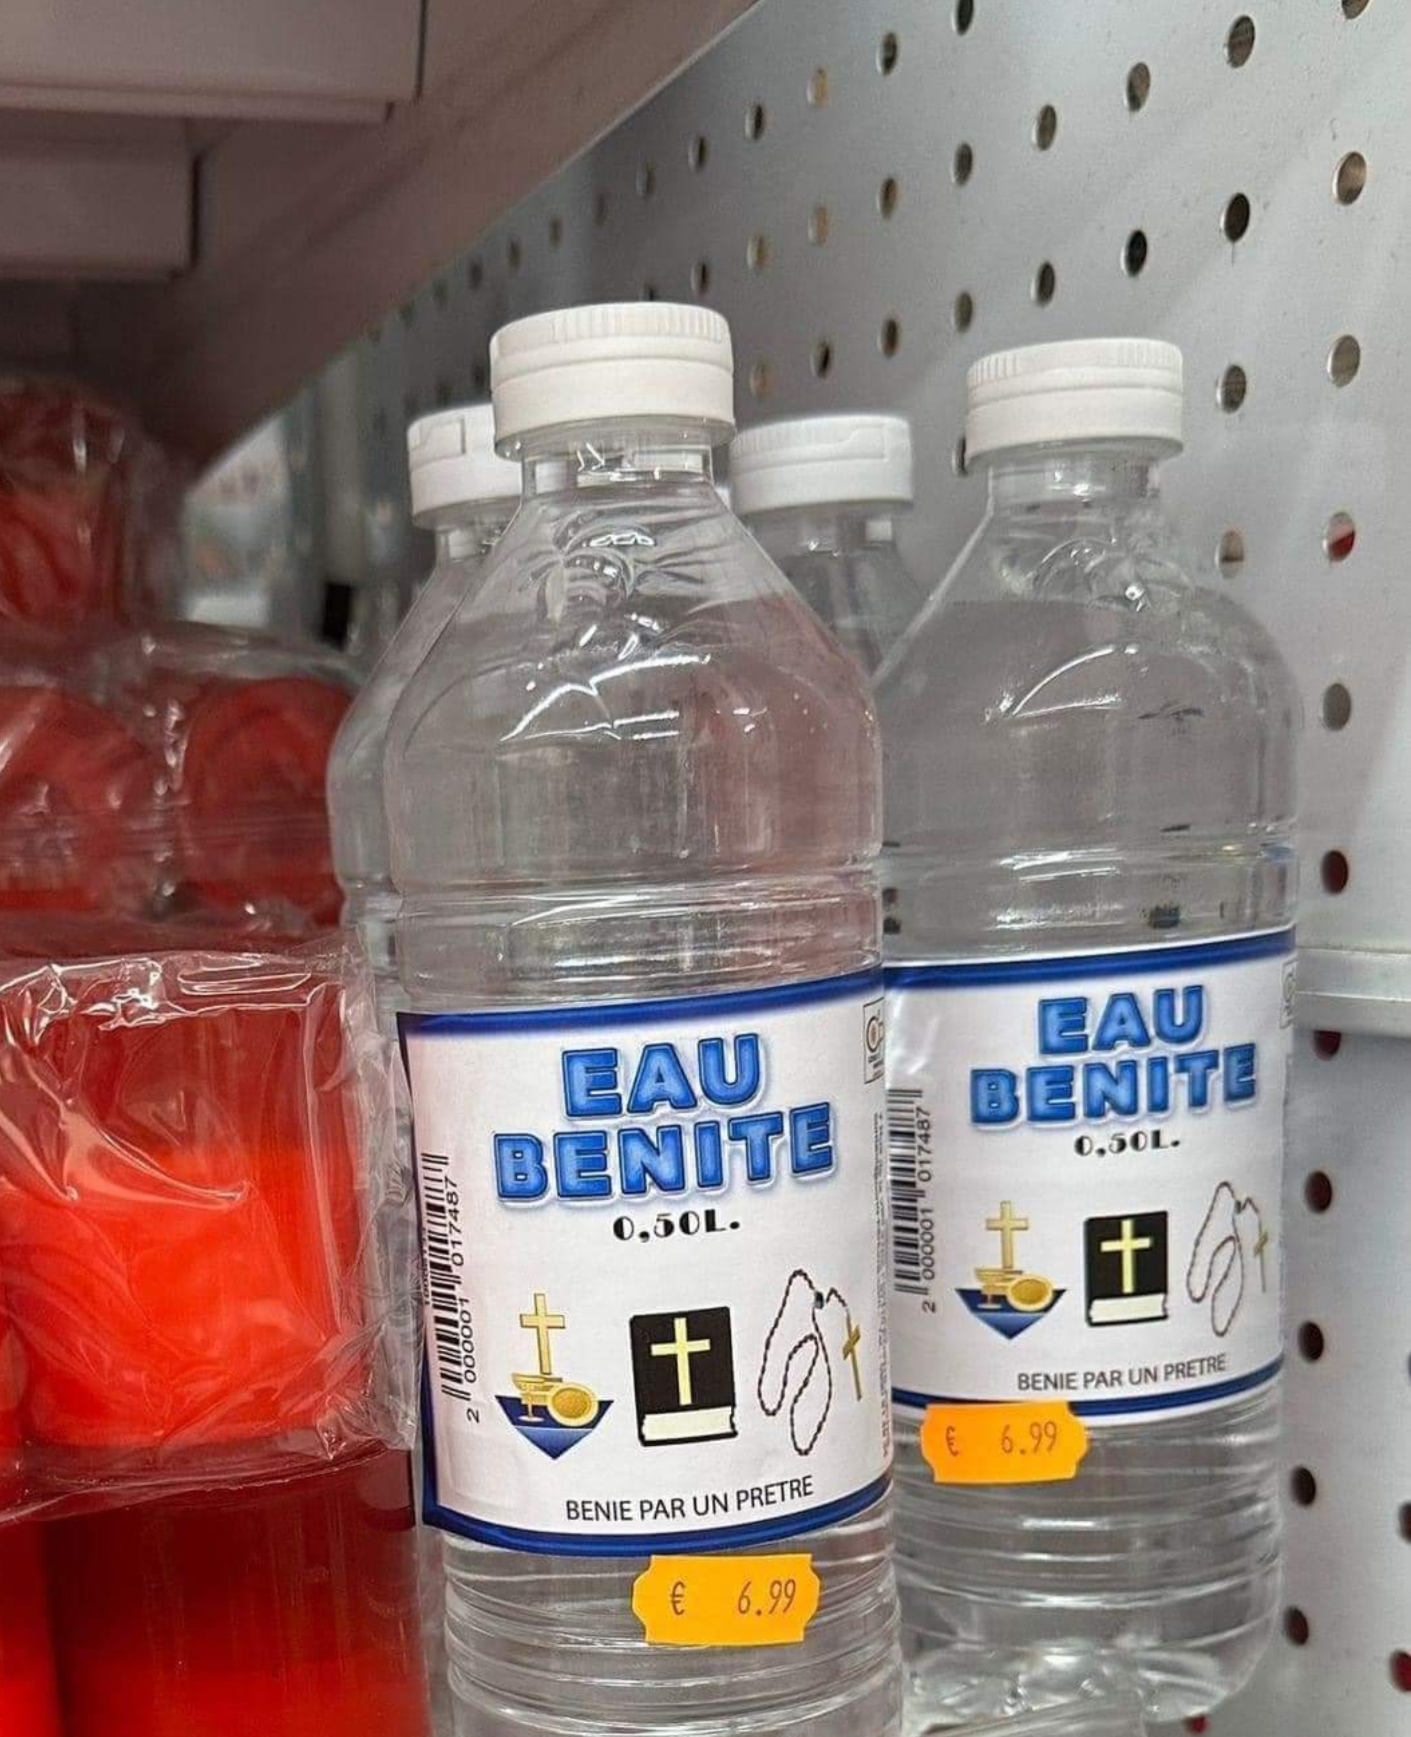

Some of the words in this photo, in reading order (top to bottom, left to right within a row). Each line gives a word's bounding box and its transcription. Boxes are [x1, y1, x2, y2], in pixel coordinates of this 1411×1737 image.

[1038, 984, 1204, 1055] EAU
[561, 1032, 760, 1117] EAU
[970, 1042, 1257, 1123] BENITE
[494, 1101, 835, 1200] BENITE
[916, 1106, 933, 1183] 017487
[444, 1175, 465, 1267] 017487
[612, 1208, 741, 1243] 0,50L.
[919, 1207, 936, 1281] 000001
[459, 1297, 477, 1384] 000001
[922, 1300, 937, 1314] 2
[1018, 1372, 1078, 1391] BENIE
[1083, 1369, 1123, 1389] PAR
[1128, 1366, 1158, 1386] UN
[1164, 1353, 1226, 1381] PRETRE
[466, 1407, 481, 1424] 2
[945, 1425, 959, 1457] €
[1001, 1420, 1057, 1455] 6.99
[566, 1500, 633, 1521] BENIE
[639, 1498, 686, 1520] PAR
[692, 1492, 729, 1517] UN
[736, 1474, 814, 1511] PRETRE
[670, 1581, 685, 1616] €
[737, 1578, 796, 1616] 6.99
